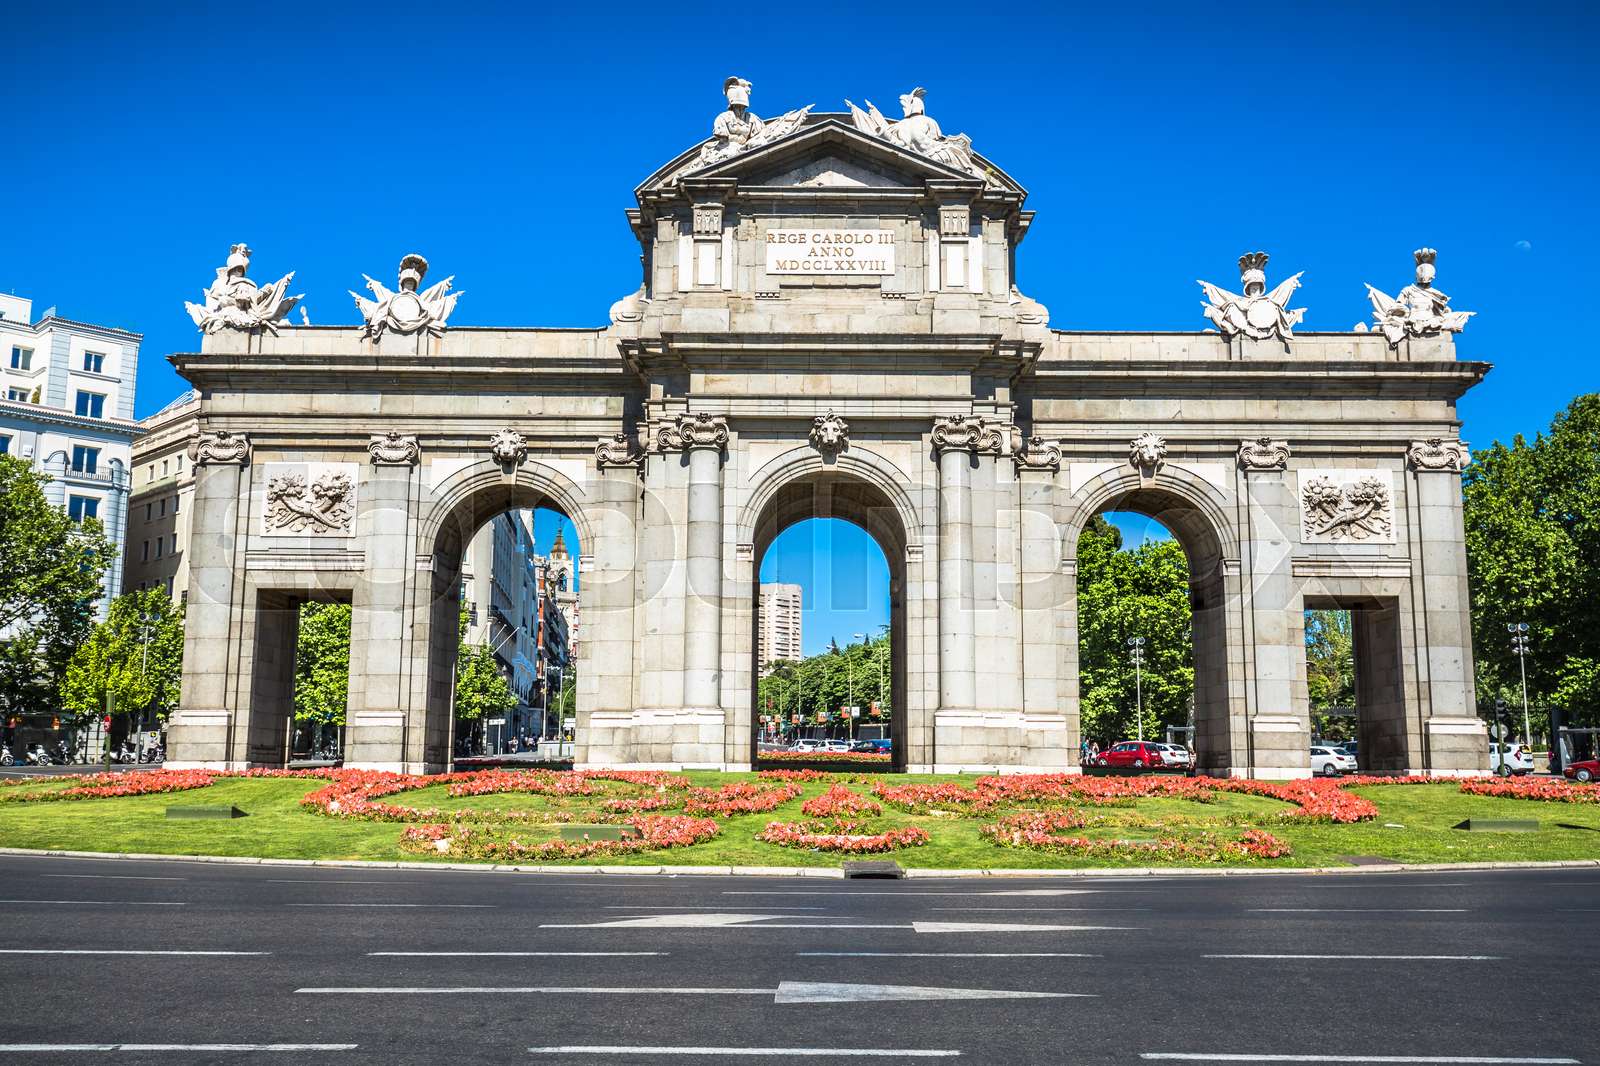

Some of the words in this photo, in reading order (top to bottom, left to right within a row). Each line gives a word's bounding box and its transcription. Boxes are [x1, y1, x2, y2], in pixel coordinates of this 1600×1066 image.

[767, 233, 807, 244] REGE
[812, 233, 873, 244] CAROLO
[878, 233, 895, 245] III
[807, 247, 854, 257] ANNO
[775, 260, 886, 271] MDCCLXXVIII
